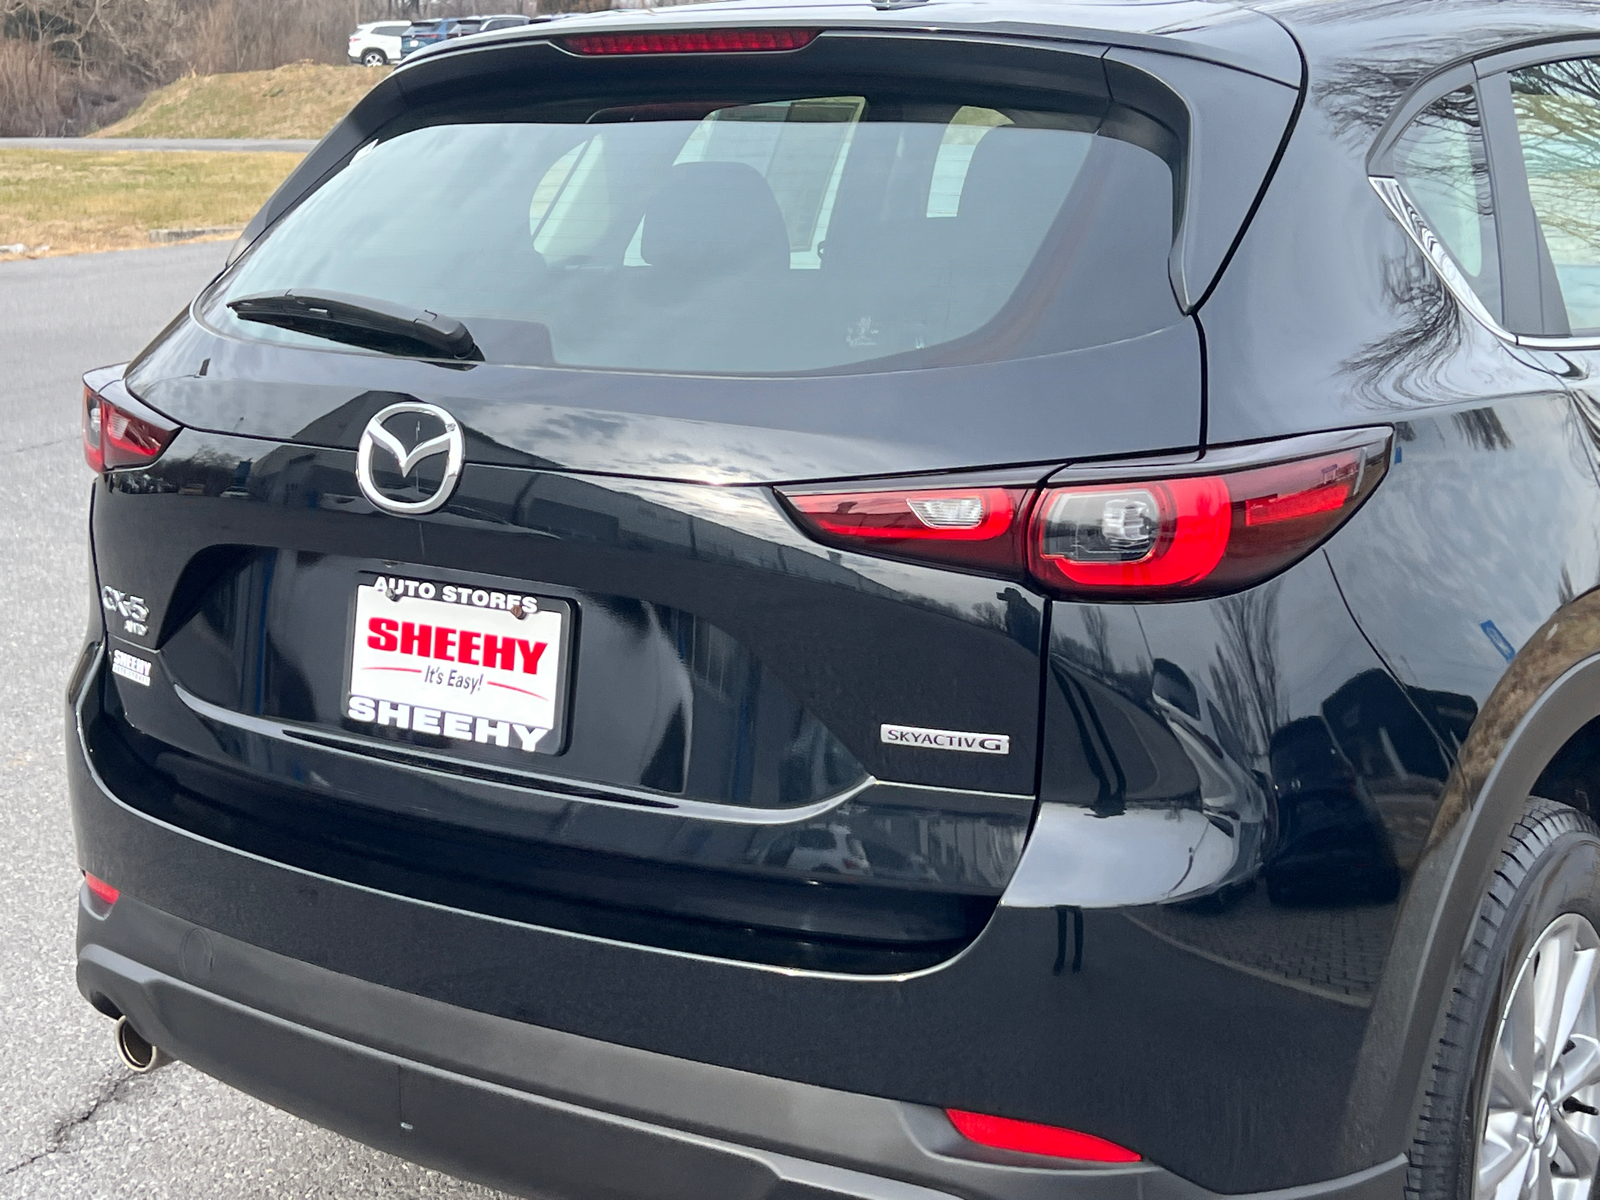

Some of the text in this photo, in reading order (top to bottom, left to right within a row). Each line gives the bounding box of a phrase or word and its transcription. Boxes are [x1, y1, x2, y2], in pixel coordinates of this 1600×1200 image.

[373, 576, 436, 599] AUTO
[367, 617, 548, 675] SHEEHY
[424, 665, 484, 694] It's Easy!
[348, 696, 548, 752] SHEEHY
